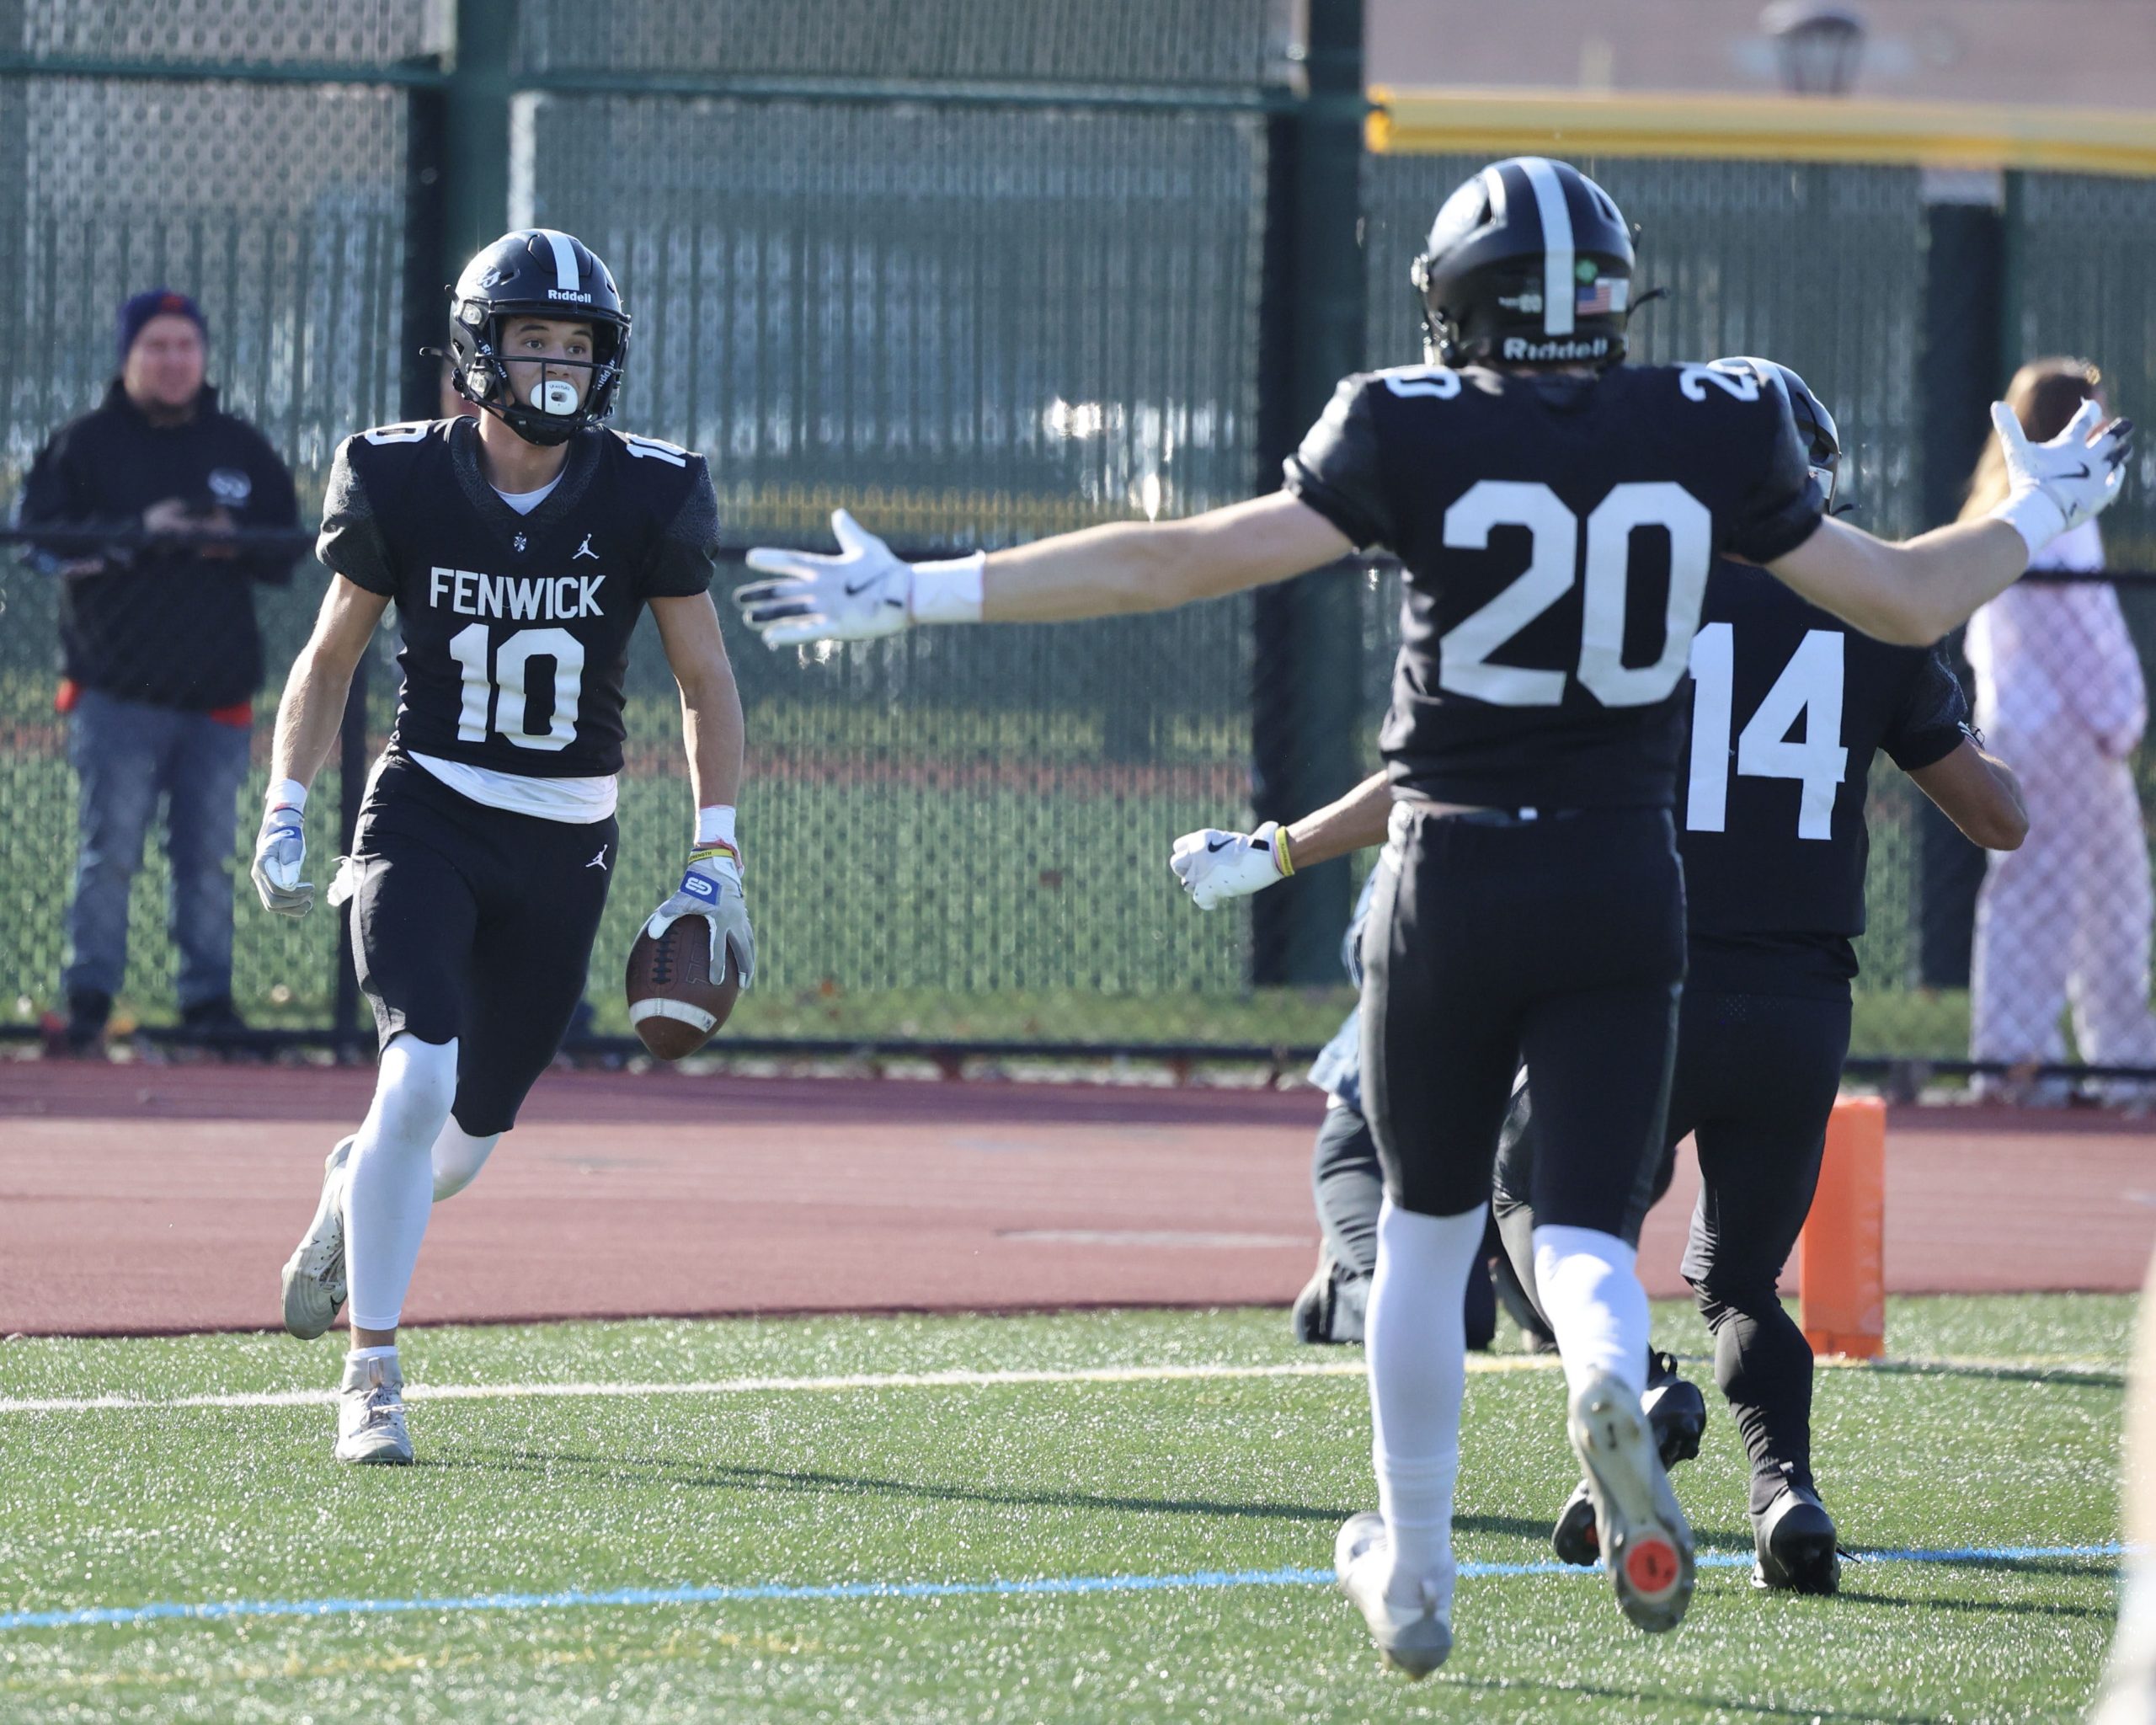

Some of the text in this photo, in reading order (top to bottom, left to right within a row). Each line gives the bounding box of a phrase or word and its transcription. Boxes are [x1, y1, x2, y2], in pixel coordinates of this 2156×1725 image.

[547, 289, 592, 303] Riddell
[1503, 336, 1608, 360] Riddell
[430, 566, 606, 620] FENWICK
[1438, 479, 1712, 707] 20
[449, 622, 585, 751] 10
[1685, 622, 1849, 840] 14
